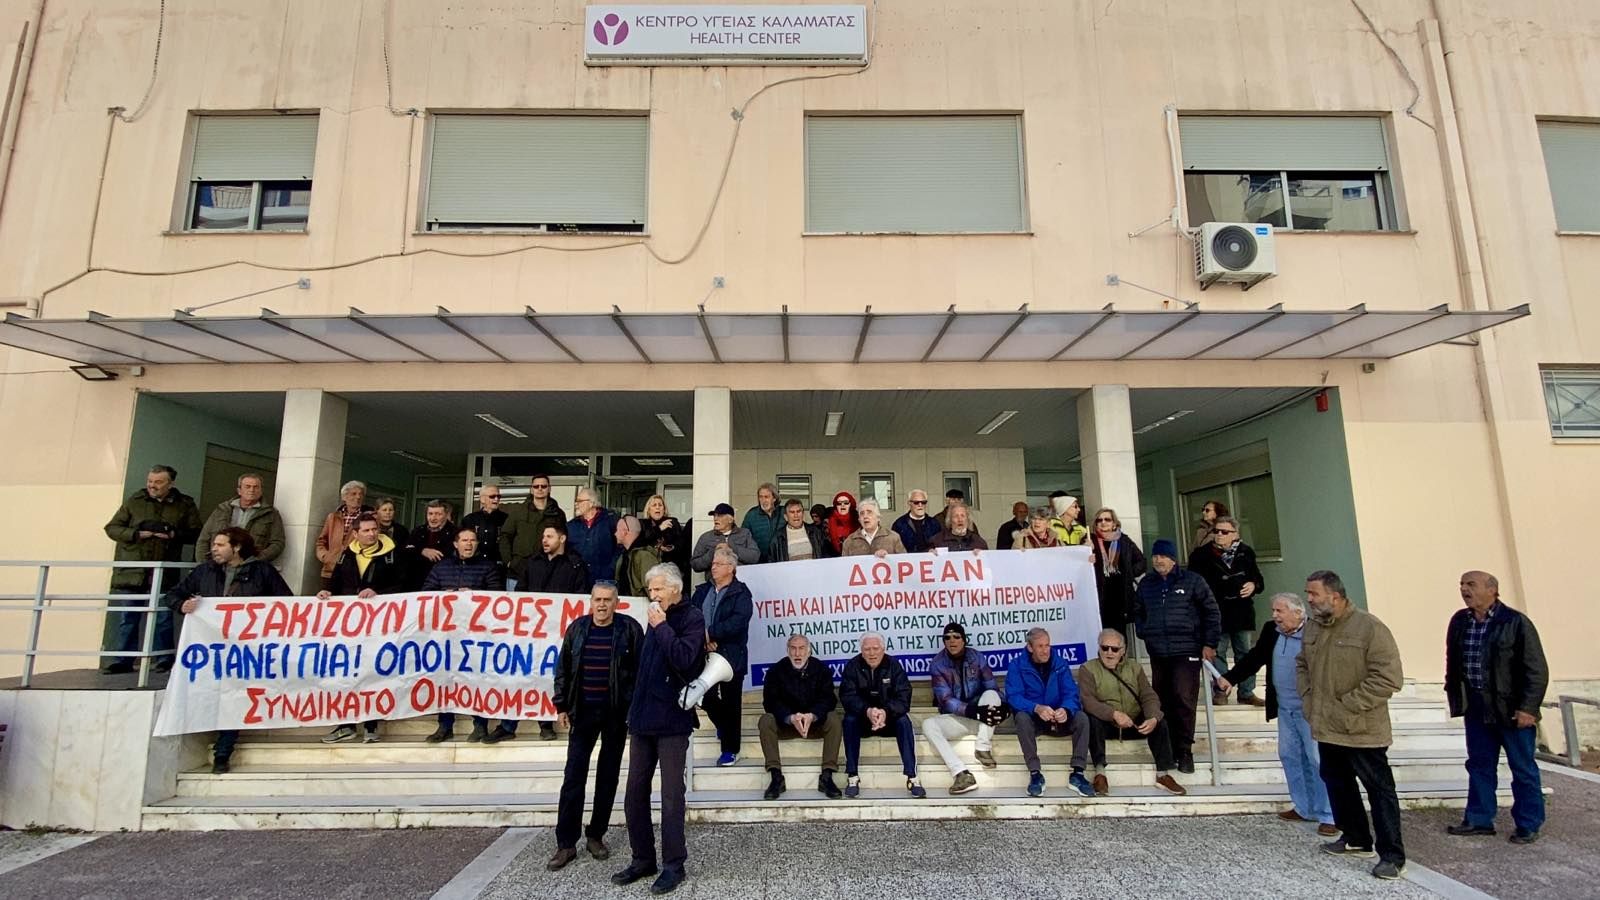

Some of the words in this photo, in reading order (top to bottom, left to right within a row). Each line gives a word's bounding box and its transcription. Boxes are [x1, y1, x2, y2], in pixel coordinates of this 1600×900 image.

[635, 15, 698, 27] ΚΕΝΤΡΟ
[703, 15, 756, 27] ΥΓΕΙΑΣ
[762, 15, 856, 27] ΚΑΛΑΜΑΤΑΣ
[690, 32, 743, 44] HEALTH
[748, 32, 801, 44] CENTER
[849, 559, 984, 587] ΔΩΡΕΑΝ
[755, 599, 797, 618] ΥΓΕΙΑ
[801, 597, 825, 616] ΚΑΙ
[830, 589, 990, 614] ΙΑΤΡΟΦΑΡΜΑΚΕΥΤΙΚΗ
[995, 583, 1075, 605] ΠΕΡΙΘΑΛΨΗ
[216, 599, 408, 641] ΤΣΑΚΙΖΟΥΝ
[417, 595, 458, 632] ΤΙΣ
[469, 595, 553, 638] ΖΩΕΣ
[767, 624, 786, 638] ΝΑ
[790, 620, 870, 636] ΣΤΑΜΑΤΗΣΕΙ
[873, 617, 890, 631] ΤΟ
[894, 615, 944, 630] ΚΡΑΤΟΣ
[972, 607, 1066, 627] ΑΝΤΙΜΕΤΩΠΙΖΕΙ
[897, 635, 923, 649] ΤΗΣ
[977, 632, 994, 646] ΩΣ
[181, 642, 290, 682] ΦΤΑΝΕΙ
[299, 641, 362, 680] ΠΙΑ!
[460, 639, 533, 676] ΣΤΟΝ
[243, 687, 397, 724] ΣΥΝΔΙΚΑΤΟ
